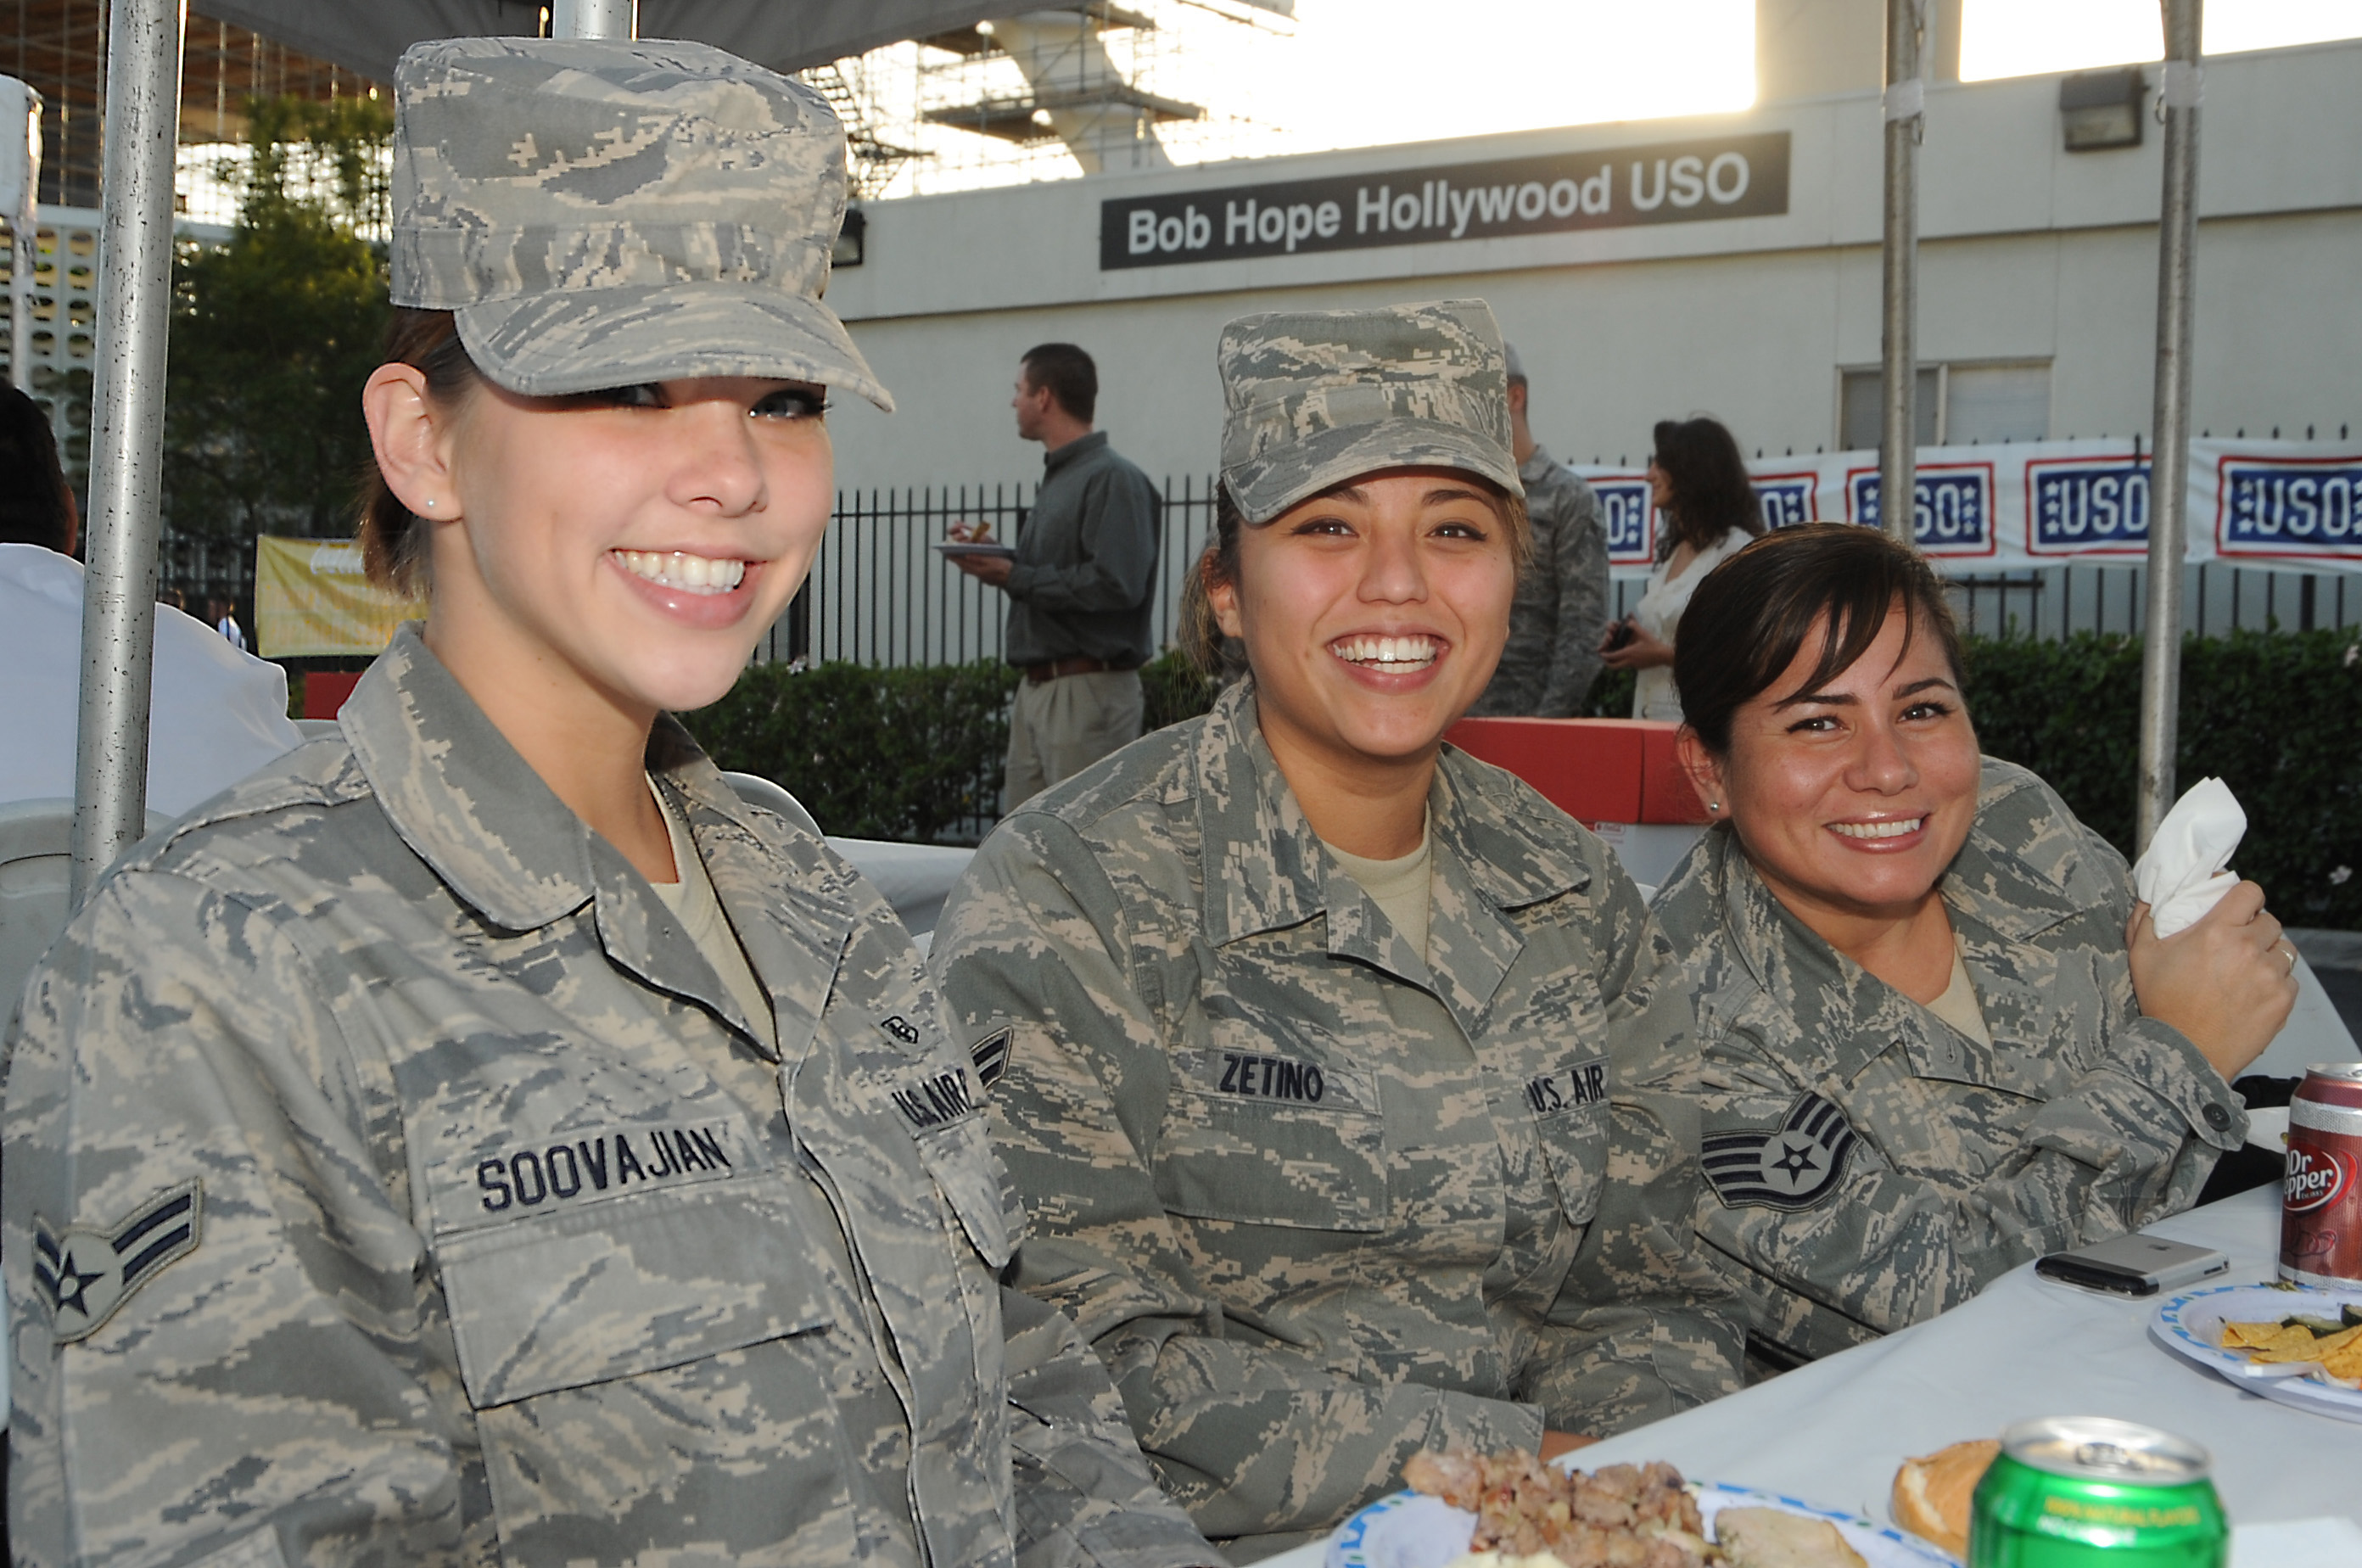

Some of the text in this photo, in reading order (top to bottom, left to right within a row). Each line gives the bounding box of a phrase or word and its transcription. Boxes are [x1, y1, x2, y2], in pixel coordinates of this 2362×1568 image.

[1128, 151, 1749, 255] Bob Hope Hollywood USO
[1915, 483, 1961, 538] SO
[2061, 473, 2152, 535] USO
[2255, 477, 2352, 536] USO
[1219, 1053, 1324, 1103] ZETINO
[1526, 1064, 1604, 1113] U.S. AIR
[477, 1127, 732, 1212] SOOVAJIAN
[2289, 1149, 2313, 1176] Dr
